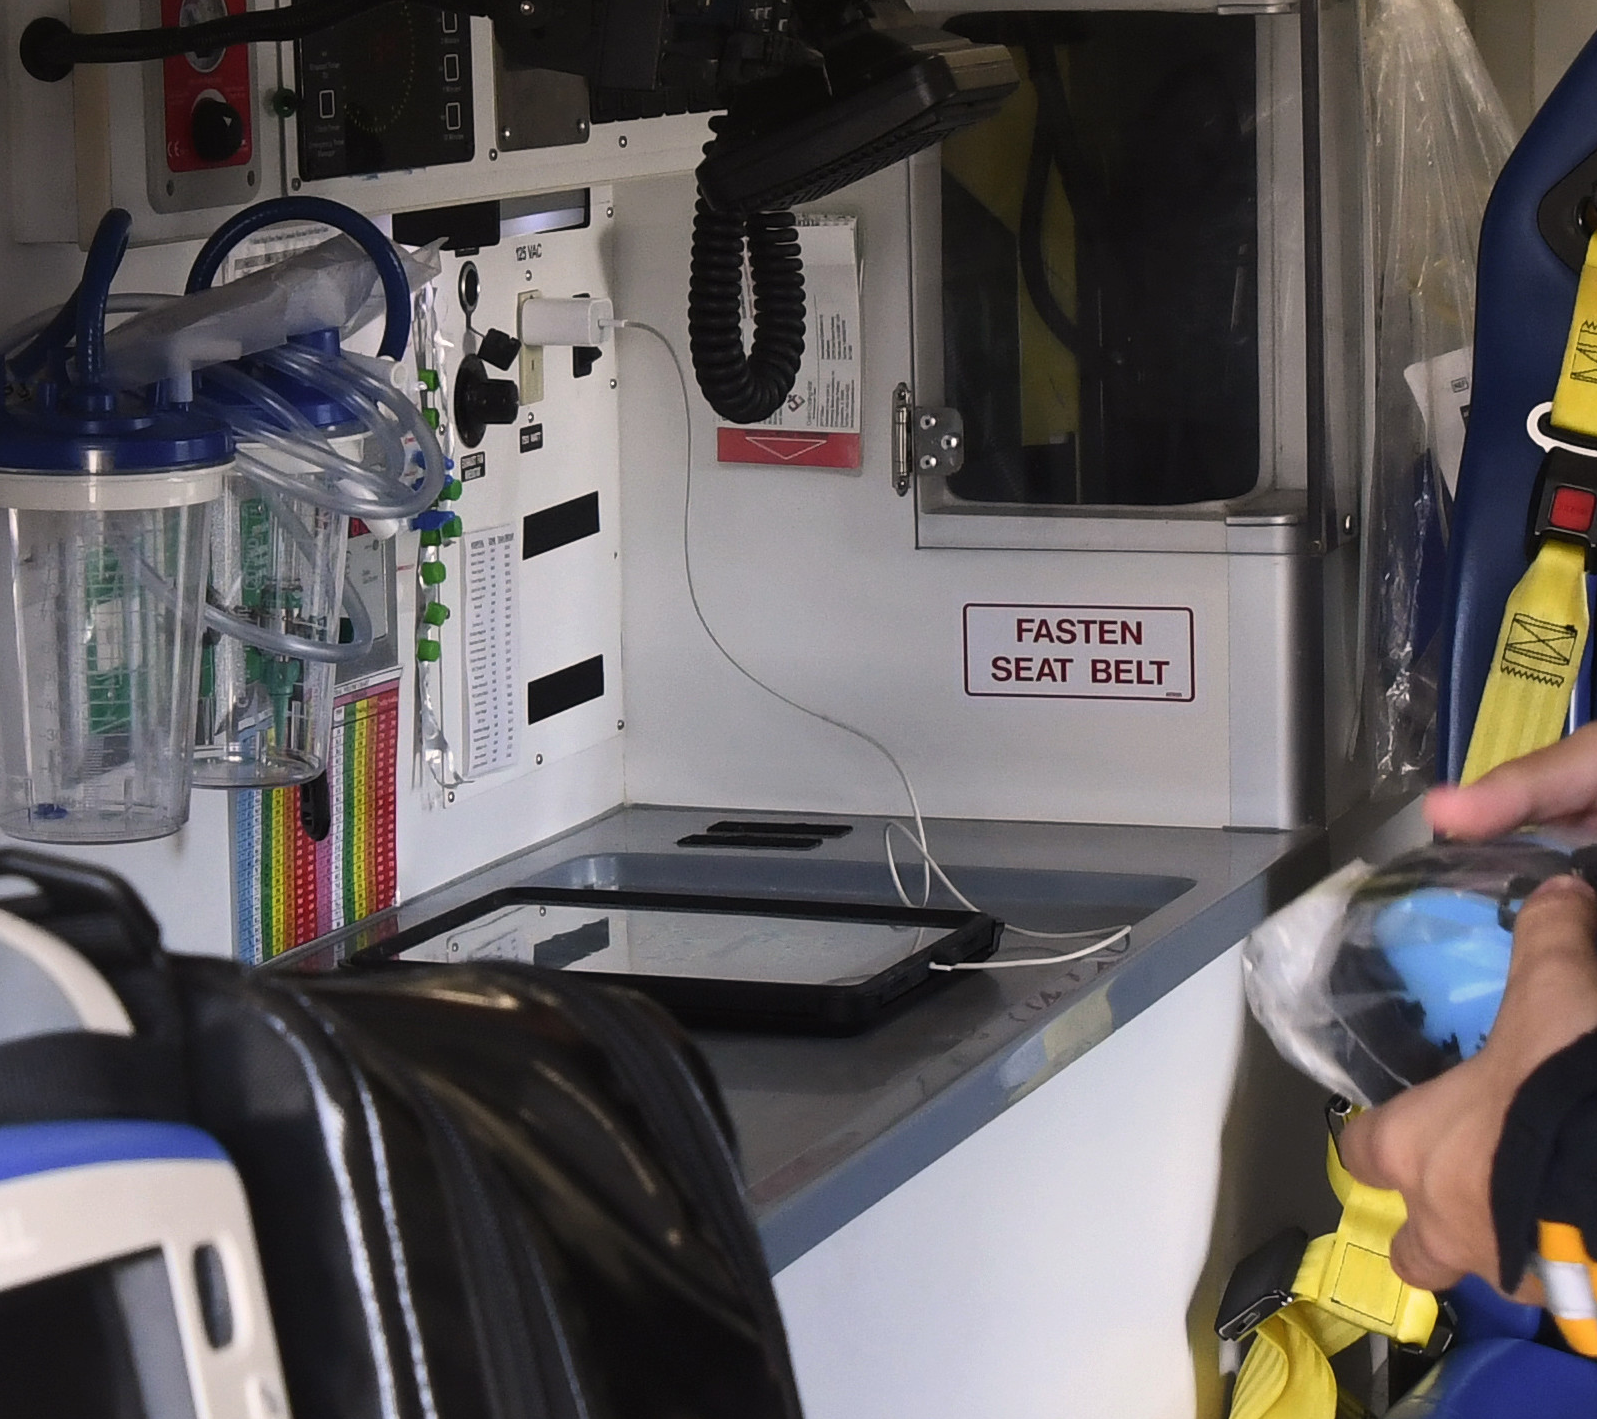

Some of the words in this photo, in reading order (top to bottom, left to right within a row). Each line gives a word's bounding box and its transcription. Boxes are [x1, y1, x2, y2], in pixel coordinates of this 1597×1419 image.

[1015, 617, 1144, 647] FASTEN
[990, 655, 1075, 684] SEAT
[1090, 658, 1171, 686] BELT
